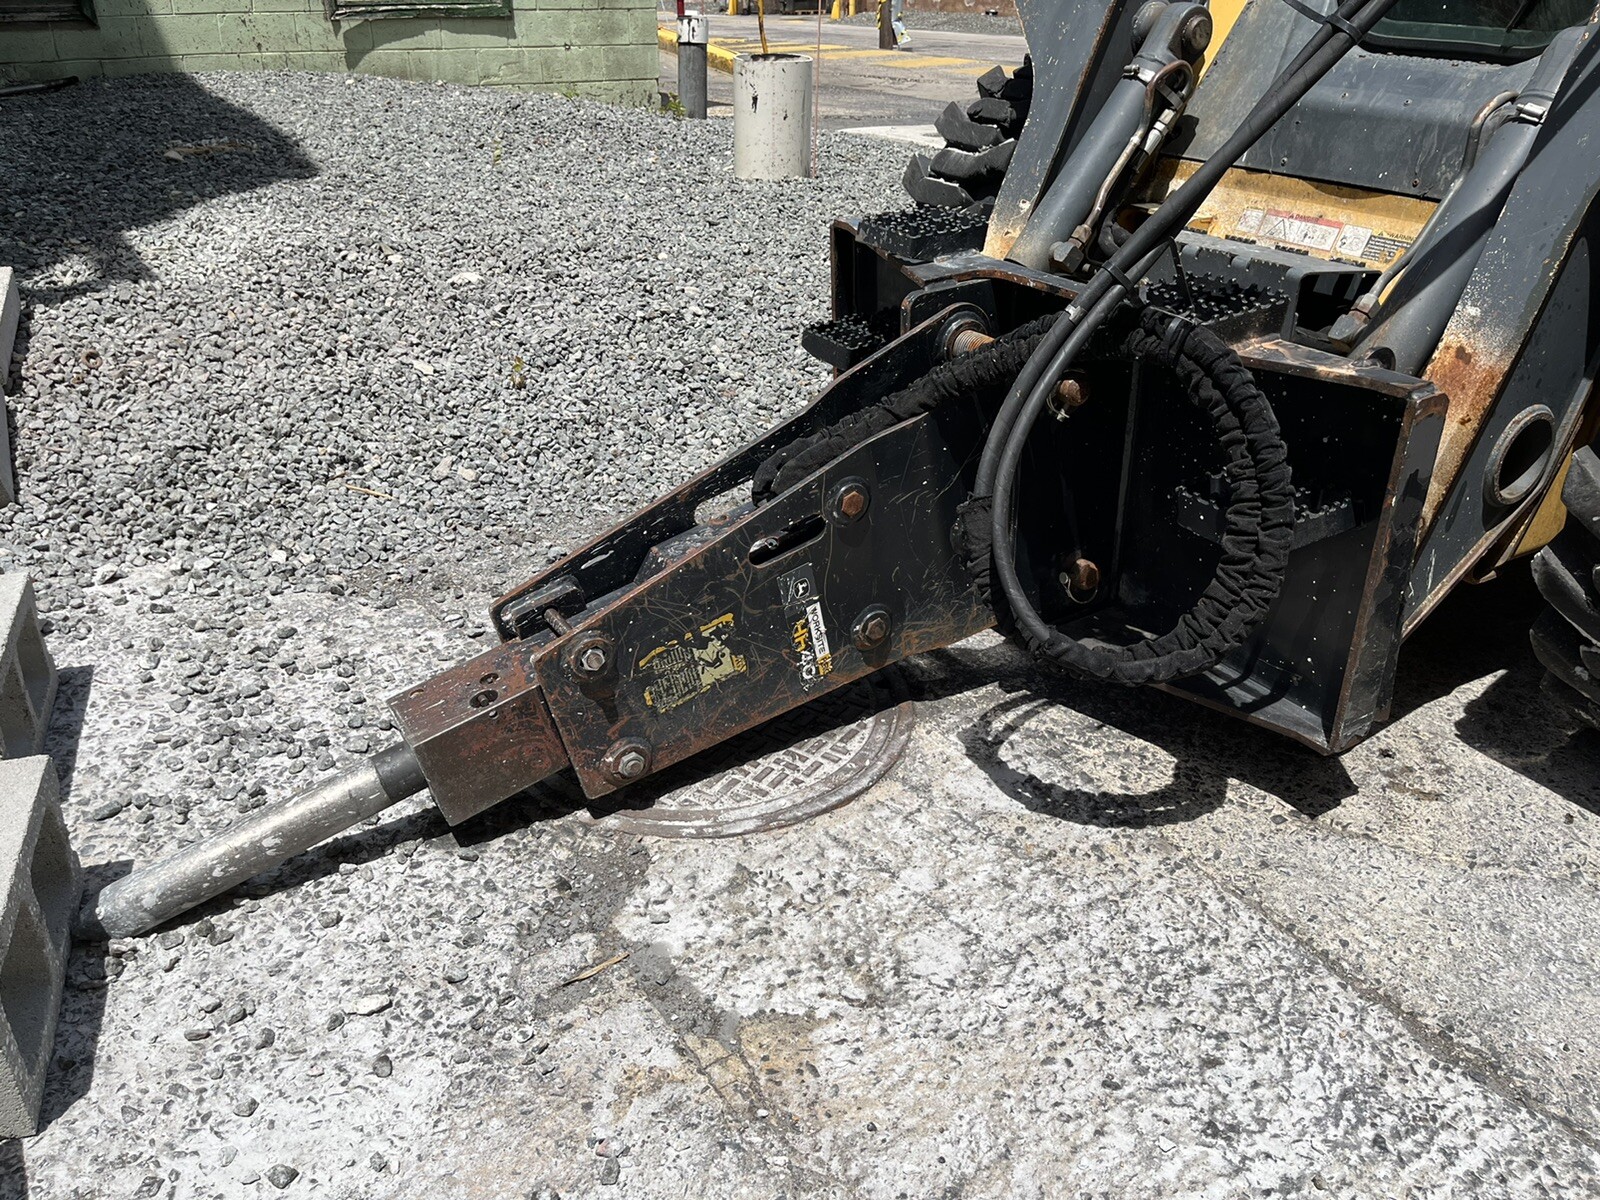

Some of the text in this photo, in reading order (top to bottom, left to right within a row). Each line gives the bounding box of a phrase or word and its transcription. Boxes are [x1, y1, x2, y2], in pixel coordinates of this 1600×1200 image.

[1294, 214, 1321, 223] DANGER
[1389, 232, 1415, 242] WARNIN
[811, 605, 826, 655] WORKSITE
